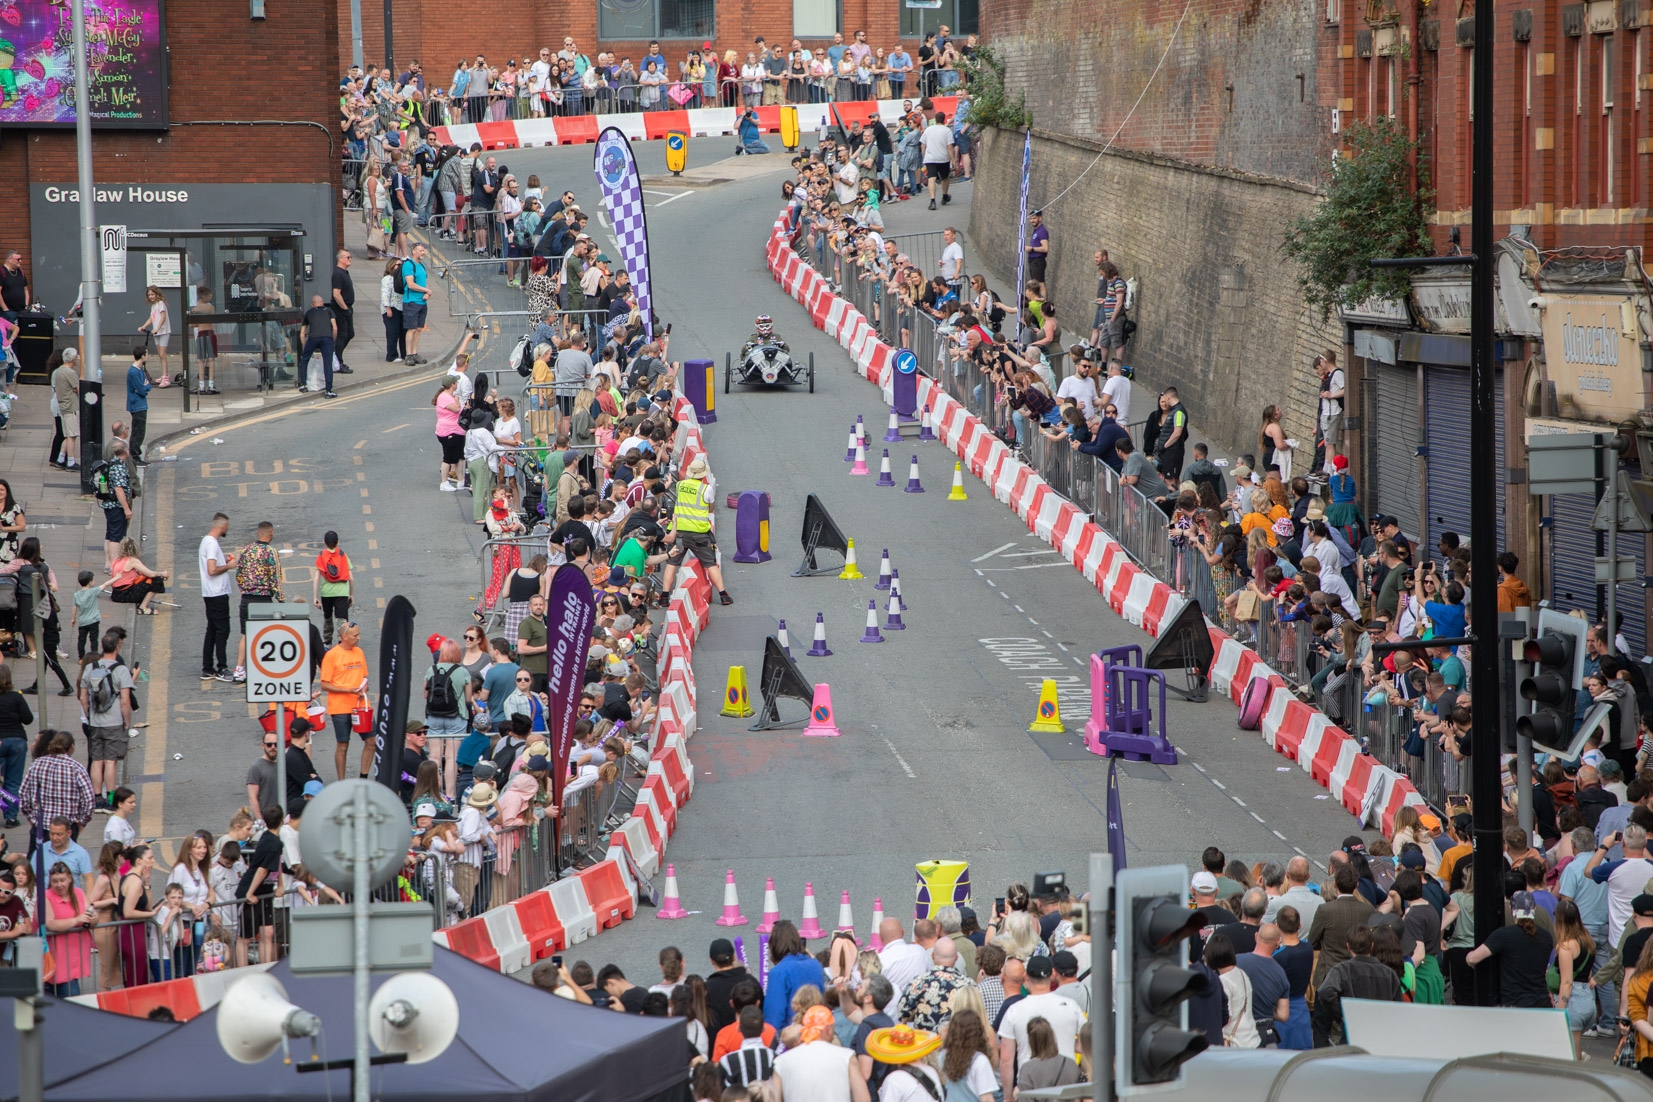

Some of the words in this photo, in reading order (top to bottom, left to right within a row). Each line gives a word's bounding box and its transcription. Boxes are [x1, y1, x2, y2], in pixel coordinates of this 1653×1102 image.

[91, 8, 110, 27] The
[114, 8, 141, 27] Eagle
[105, 27, 140, 48] McCoy
[89, 47, 133, 67] Lavender
[94, 68, 127, 86] Simon
[111, 86, 136, 106] Meir
[111, 111, 142, 119] Productions
[45, 186, 123, 203] Gralaw
[128, 186, 189, 203] House
[201, 457, 318, 479] BUS
[177, 478, 353, 500] STOP
[569, 598, 583, 643] INTRANET
[260, 640, 297, 662] 20
[549, 639, 567, 694] hello
[558, 591, 577, 638] halo
[978, 637, 1069, 670] COACH
[571, 663, 579, 675] in
[253, 682, 303, 696] ZONE
[566, 674, 577, 703] teams
